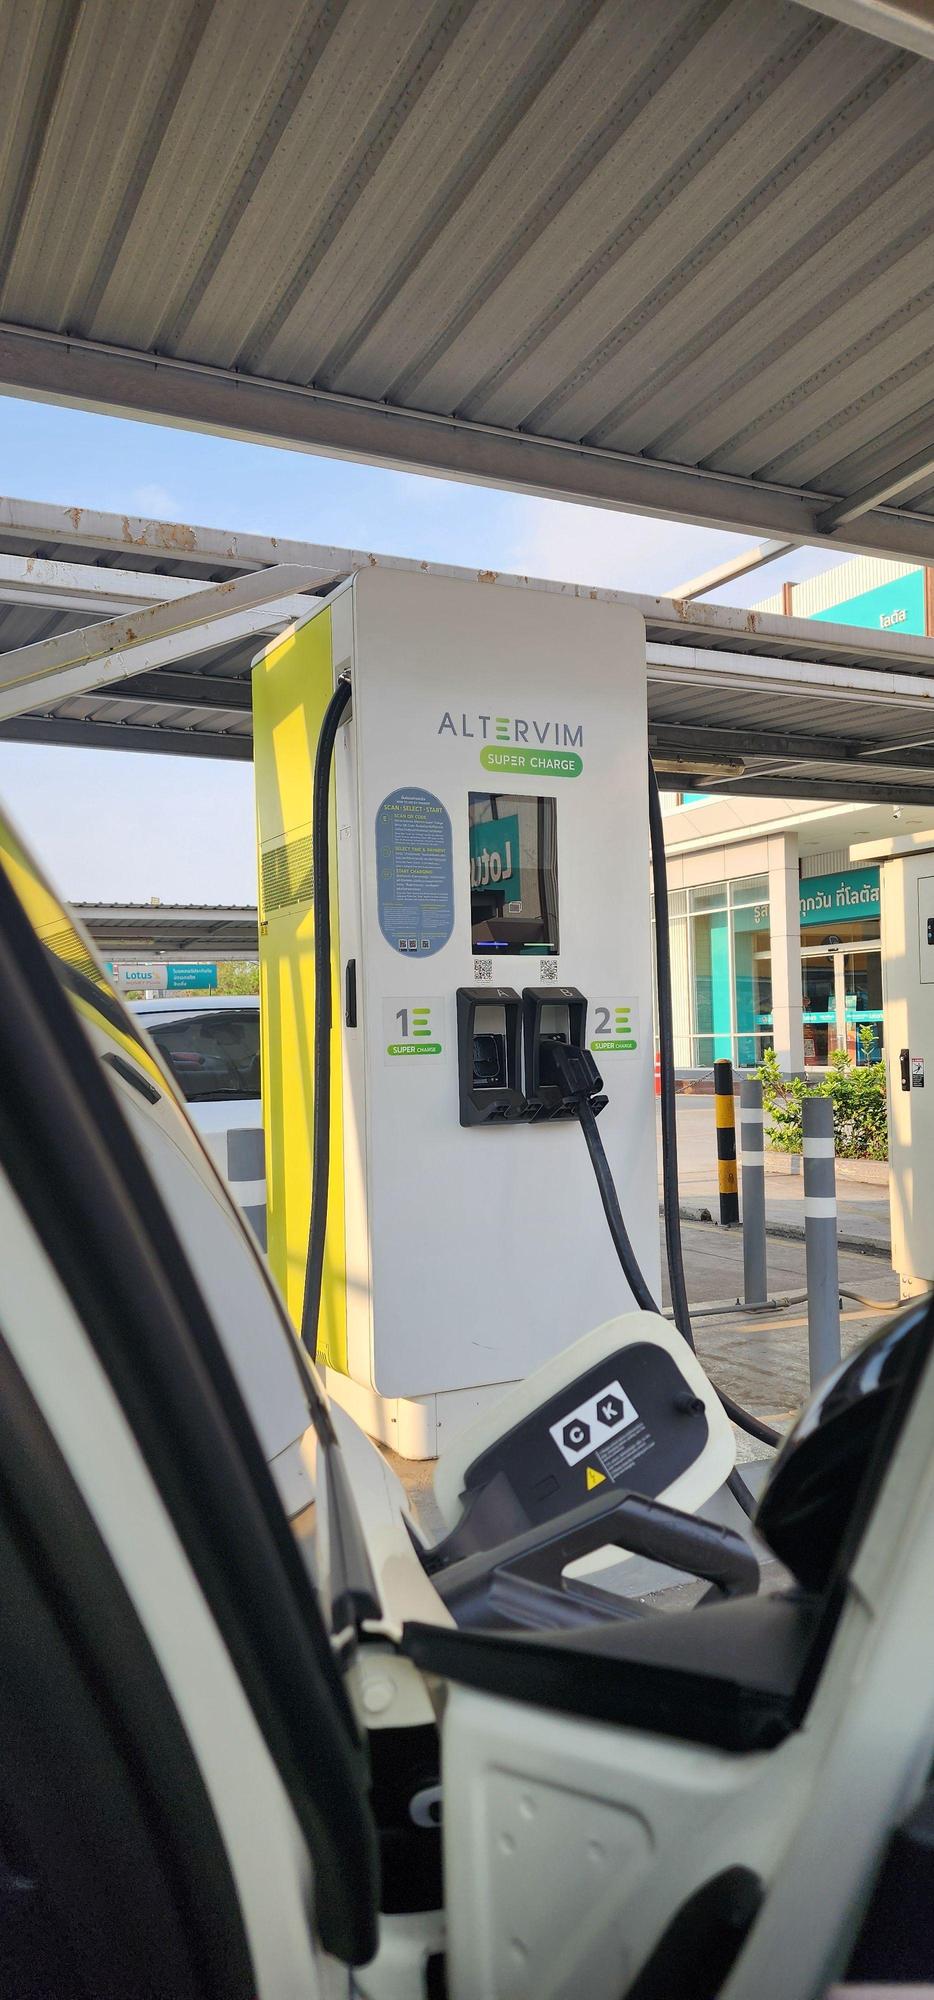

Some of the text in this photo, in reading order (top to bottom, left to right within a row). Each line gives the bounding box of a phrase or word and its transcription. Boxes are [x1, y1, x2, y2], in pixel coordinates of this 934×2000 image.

[438, 711, 583, 747] ALTERVIM
[488, 753, 576, 771] SUPER CHARGE
[497, 989, 510, 998] A
[560, 988, 574, 997] B
[392, 1045, 416, 1054] SUPER
[594, 1041, 615, 1050] SUPER
[601, 1402, 618, 1421] K
[569, 1426, 585, 1444] C
